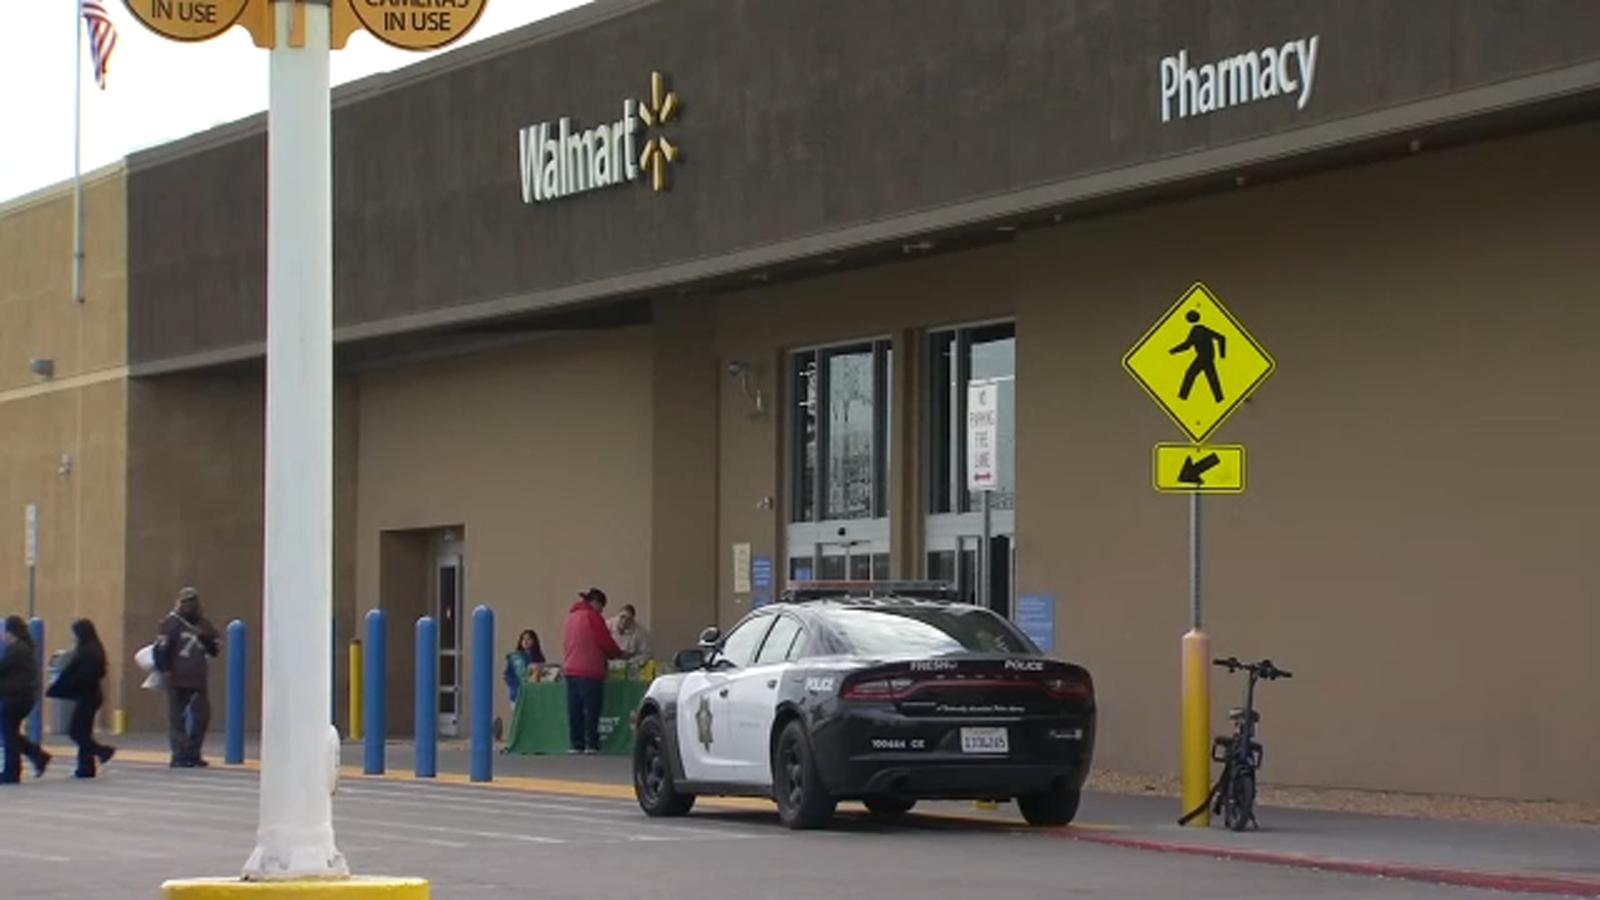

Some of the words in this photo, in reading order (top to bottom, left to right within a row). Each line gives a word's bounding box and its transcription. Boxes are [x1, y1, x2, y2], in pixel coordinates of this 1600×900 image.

[151, 0, 173, 19] IN
[179, 2, 216, 23] USE
[384, 12, 406, 31] IN
[412, 12, 451, 31] USE
[1160, 35, 1319, 123] Pharmacy
[519, 98, 639, 203] Walmart
[1004, 659, 1045, 672] POLICE
[804, 676, 836, 692] POLICE
